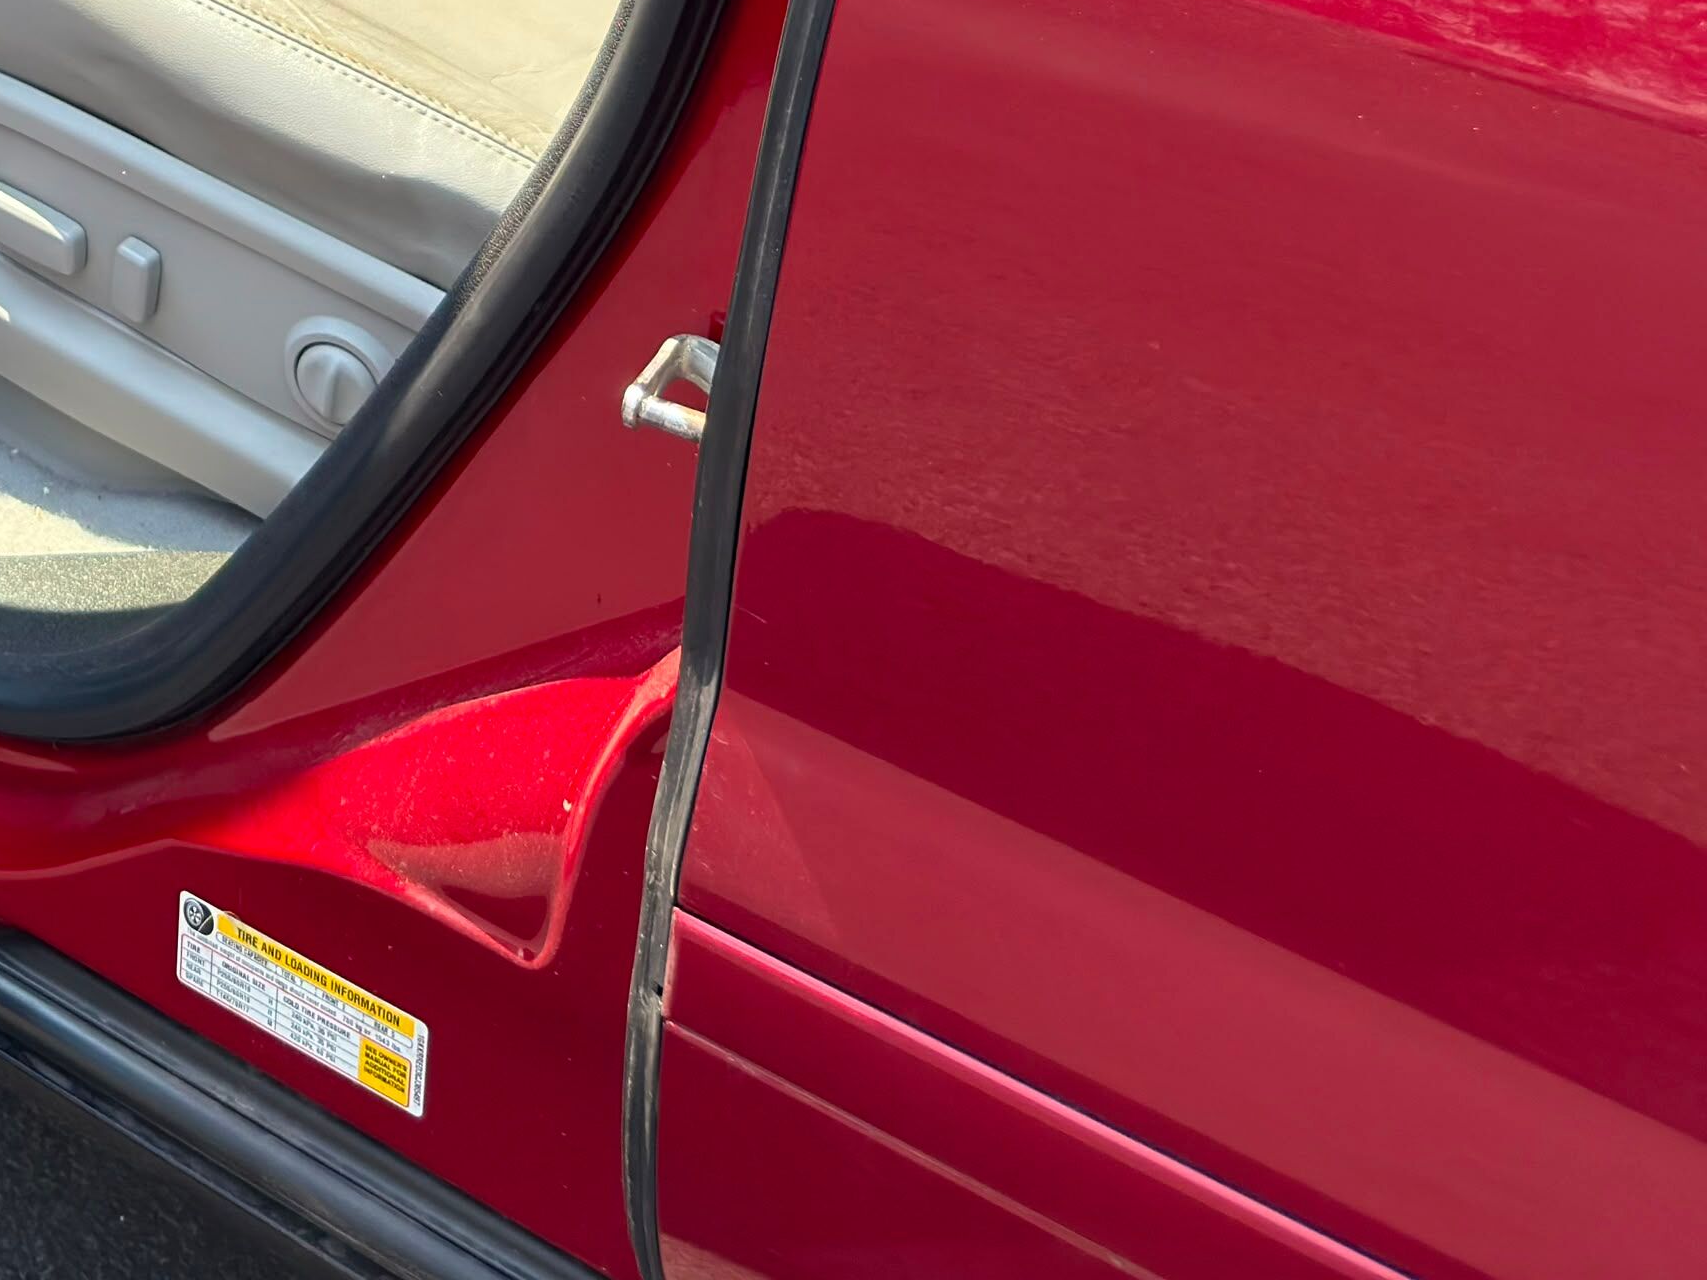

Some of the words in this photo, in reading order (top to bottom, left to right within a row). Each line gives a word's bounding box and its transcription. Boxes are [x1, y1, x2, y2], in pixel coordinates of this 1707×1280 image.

[221, 960, 251, 983] ORIGINAL
[237, 927, 258, 950] TIRE
[261, 940, 281, 962] AND
[284, 953, 327, 988] LOADING
[330, 979, 400, 1028] INFORMATION
[283, 995, 301, 1012] COLD
[301, 1005, 316, 1021] TIRE
[316, 1014, 350, 1040] PRESSURE
